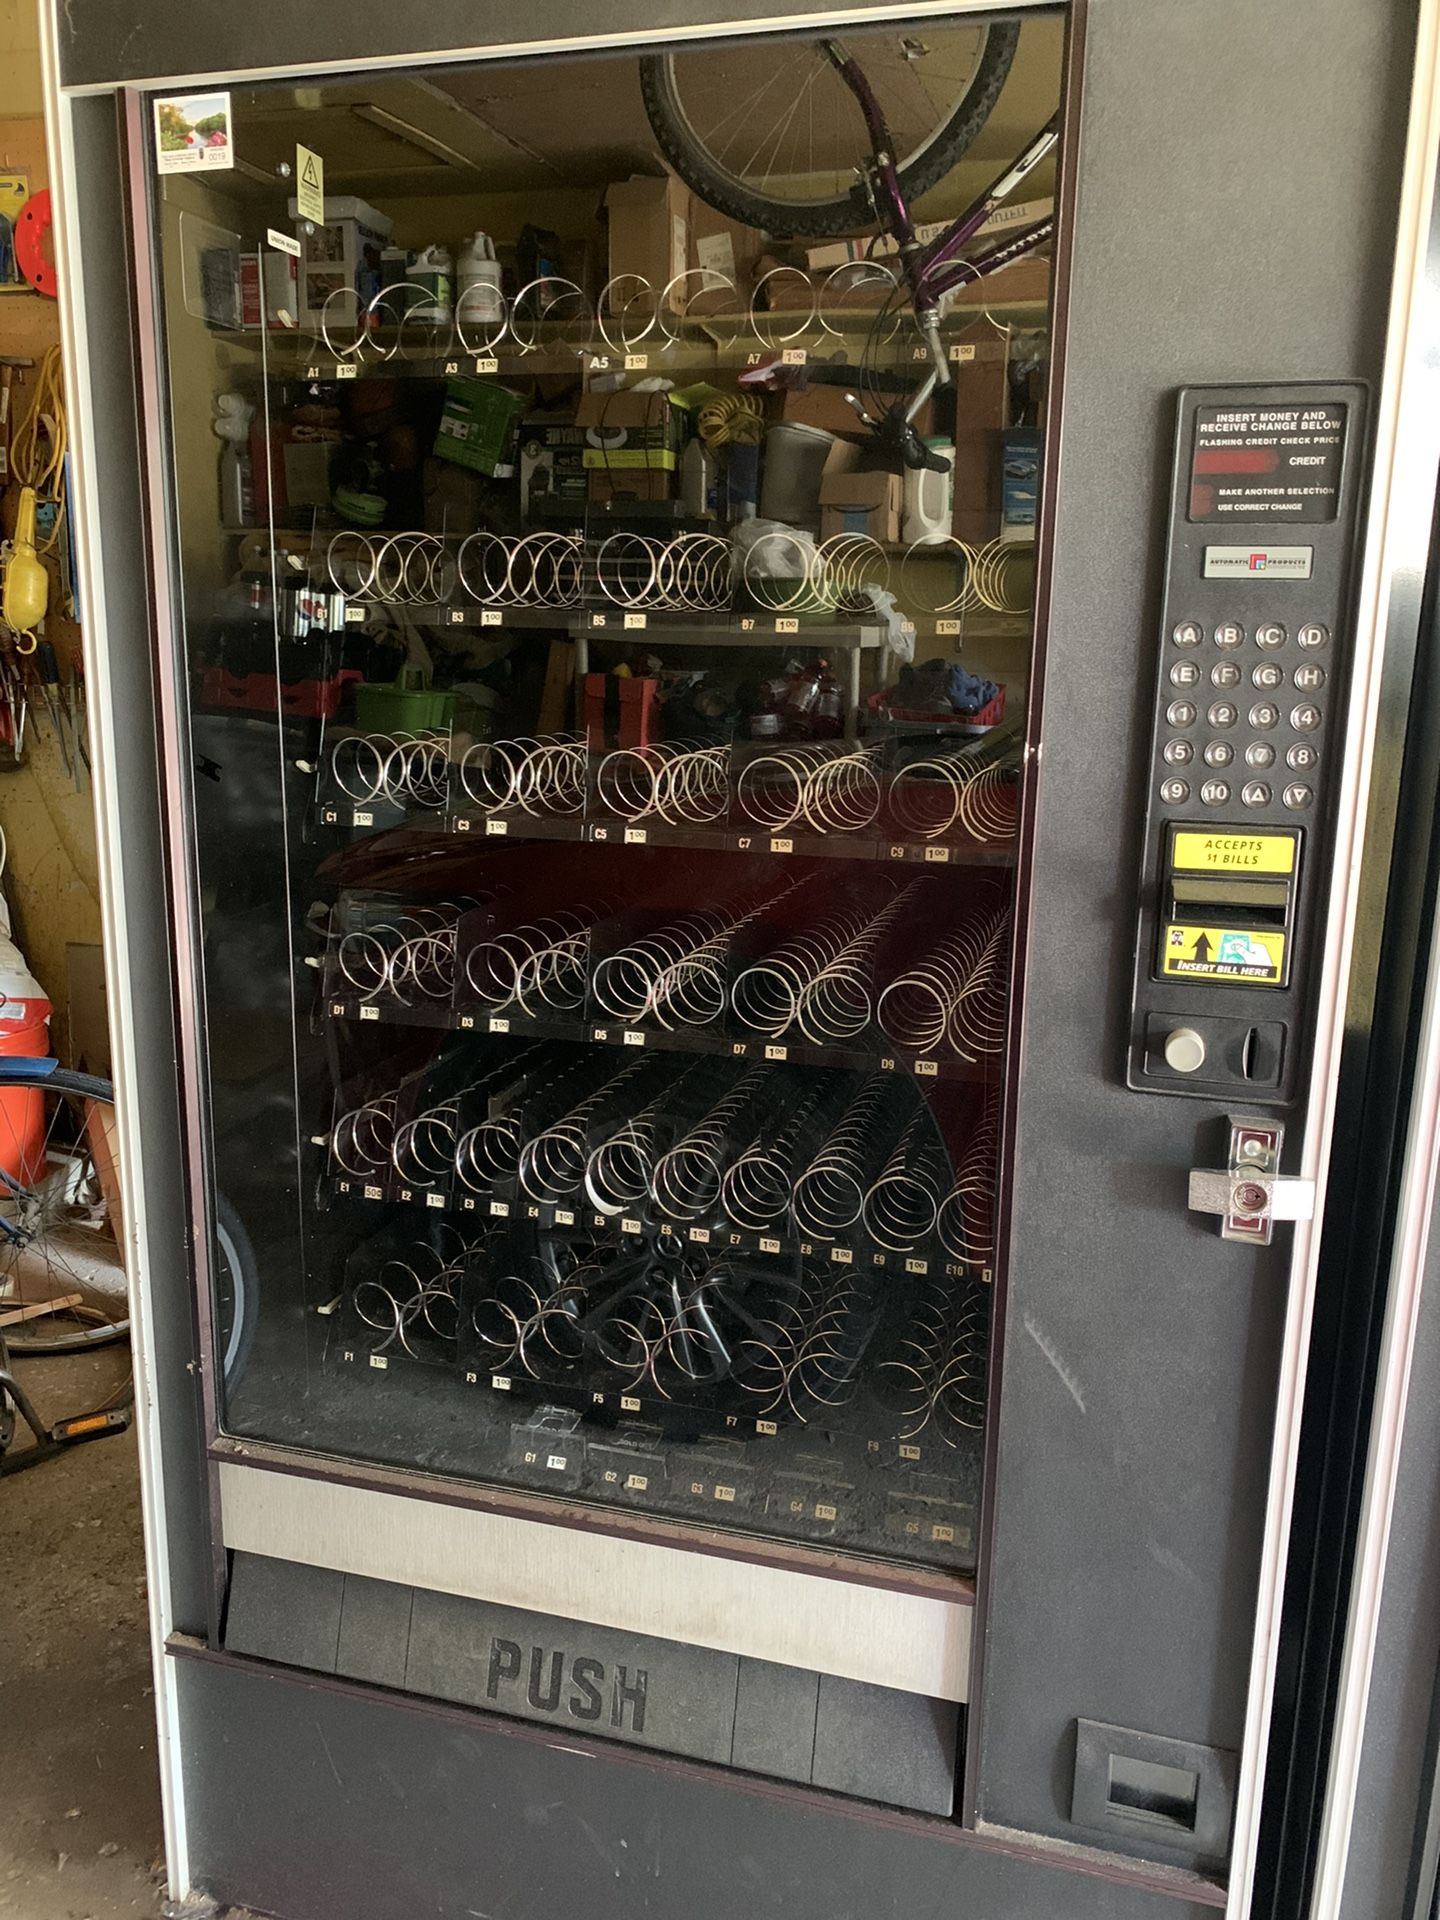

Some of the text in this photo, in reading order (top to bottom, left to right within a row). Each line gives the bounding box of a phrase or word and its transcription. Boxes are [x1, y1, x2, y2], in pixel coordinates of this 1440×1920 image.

[747, 353, 761, 365] A7
[913, 348, 927, 360] A9
[445, 363, 458, 374] A3
[590, 357, 609, 369] A5
[308, 367, 319, 378] A1
[1217, 412, 1326, 423] INSERT MONEY AND
[1200, 420, 1342, 432] RECEIVE CHANGE BELOW
[1200, 436, 1340, 447] FLASHING CREDIT CHECK PRICE
[1289, 456, 1326, 466] CREDIT
[1219, 487, 1335, 496] MAKE ANOTHER SELECTION
[1218, 503, 1302, 512] USE CORRECT CHANGE
[452, 612, 464, 624] B3
[593, 615, 606, 626] B5
[1183, 628, 1322, 645] A B C D
[1180, 667, 1318, 685] E F G H
[1180, 707, 1313, 724] 1 2 3 4
[1174, 745, 1309, 764] 5 6 7 8
[1171, 783, 1228, 800] 9 10
[326, 812, 337, 823] C1
[458, 820, 470, 832] C3
[595, 828, 607, 840] C5
[738, 838, 751, 849] C7
[1204, 840, 1263, 852] ACCEPTS
[890, 847, 904, 858] C9
[1207, 853, 1259, 865] $1 BILLS
[1177, 960, 1269, 977] INSERT BILL HERE
[334, 1004, 344, 1016] D1
[461, 1017, 474, 1028] D3
[594, 1030, 607, 1040] D5
[733, 1044, 746, 1055] D7
[881, 1058, 895, 1070] D9
[340, 1182, 350, 1192] E1
[402, 1190, 412, 1200] E2
[464, 1199, 474, 1210] E3
[528, 1206, 539, 1217] E4
[594, 1216, 606, 1226] E5
[661, 1224, 672, 1235] E6
[730, 1234, 741, 1244] E7
[800, 1244, 812, 1255] E8
[874, 1254, 885, 1264] E9
[946, 1264, 964, 1276] E10
[344, 1352, 354, 1362] F1
[466, 1372, 478, 1383] F3
[593, 1392, 604, 1404] F5
[726, 1416, 738, 1427] F7
[868, 1440, 880, 1452] F9
[524, 1452, 536, 1463] G1
[604, 1472, 617, 1482] G2
[691, 1482, 704, 1494] G3
[790, 1500, 802, 1512] G4
[906, 1522, 918, 1534] G5
[486, 1637, 649, 1732] PUSH
